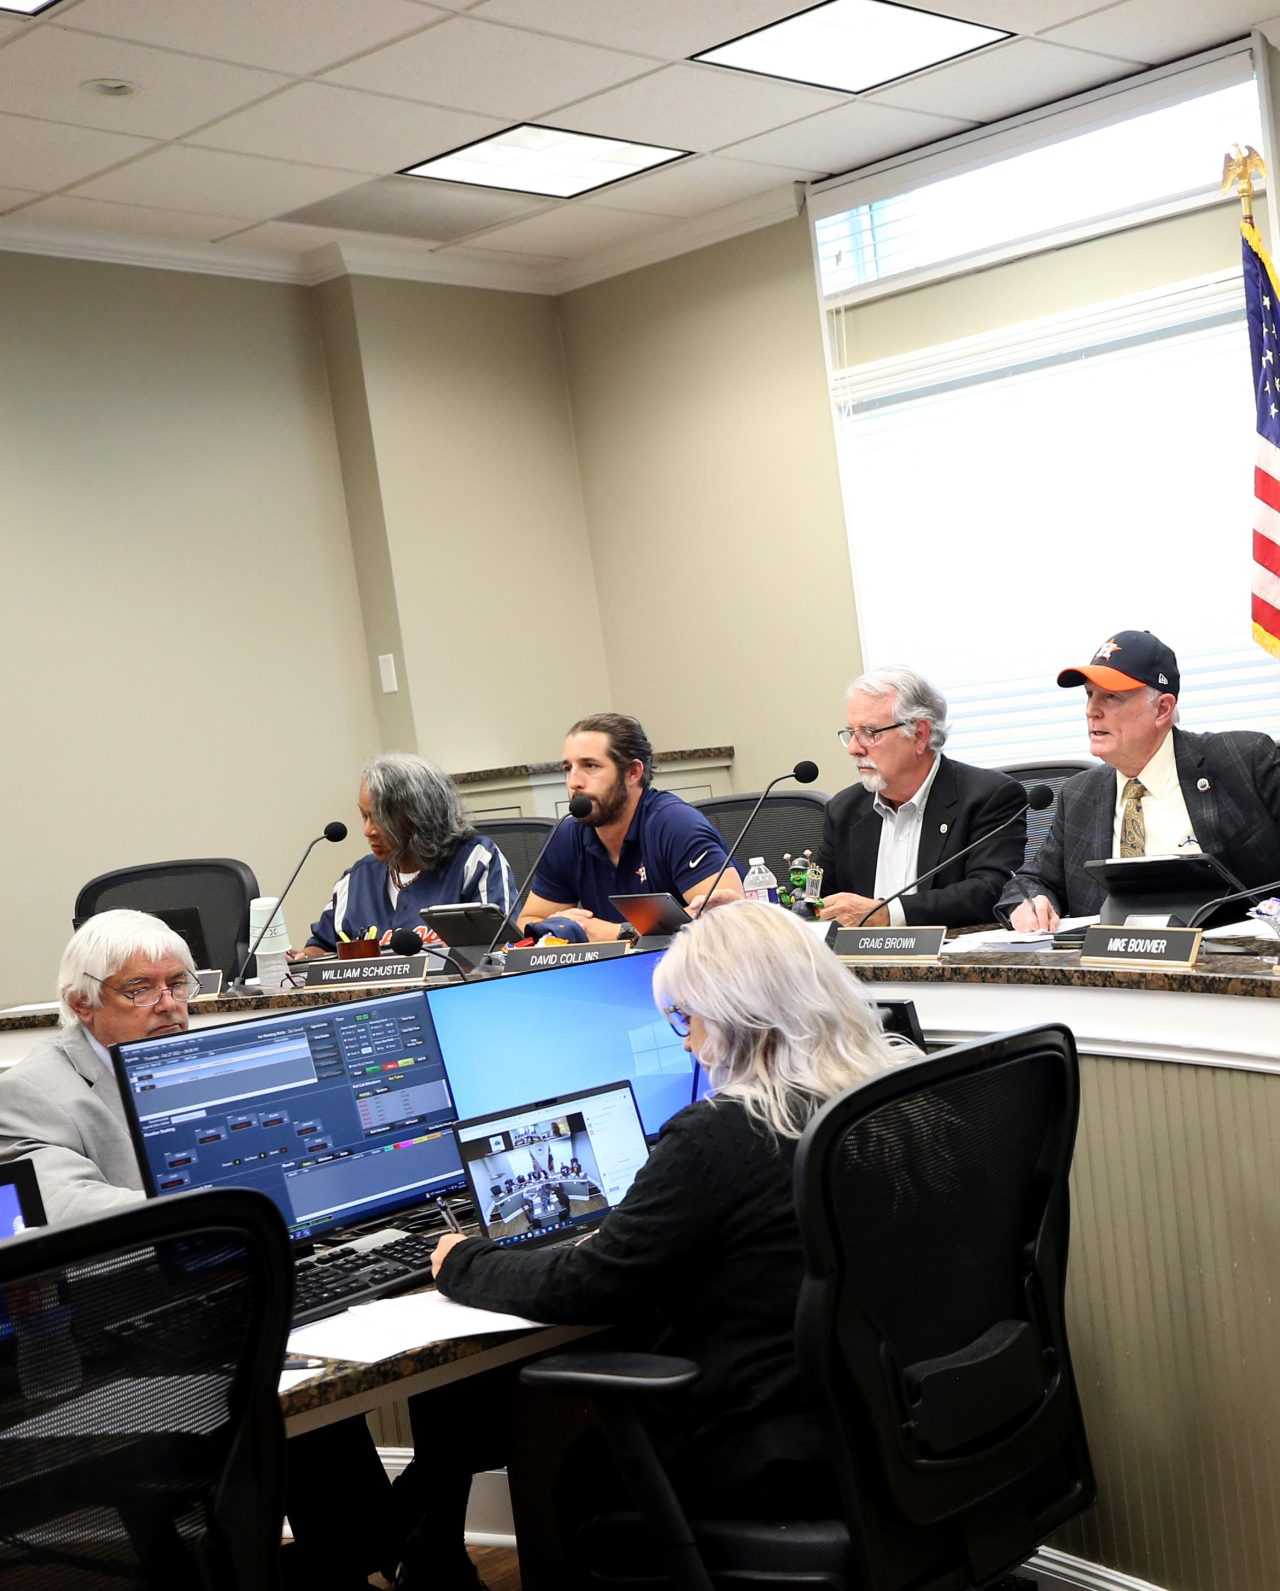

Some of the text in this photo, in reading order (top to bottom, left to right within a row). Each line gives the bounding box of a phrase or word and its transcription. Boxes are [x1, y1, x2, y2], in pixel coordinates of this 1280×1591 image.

[858, 937, 916, 949] CRAIG BROWN
[1107, 938, 1167, 954] MIKE BOUVIER
[529, 951, 599, 966] DAVID COLLINS
[321, 964, 410, 980] WILLIAM SCHUSTER
